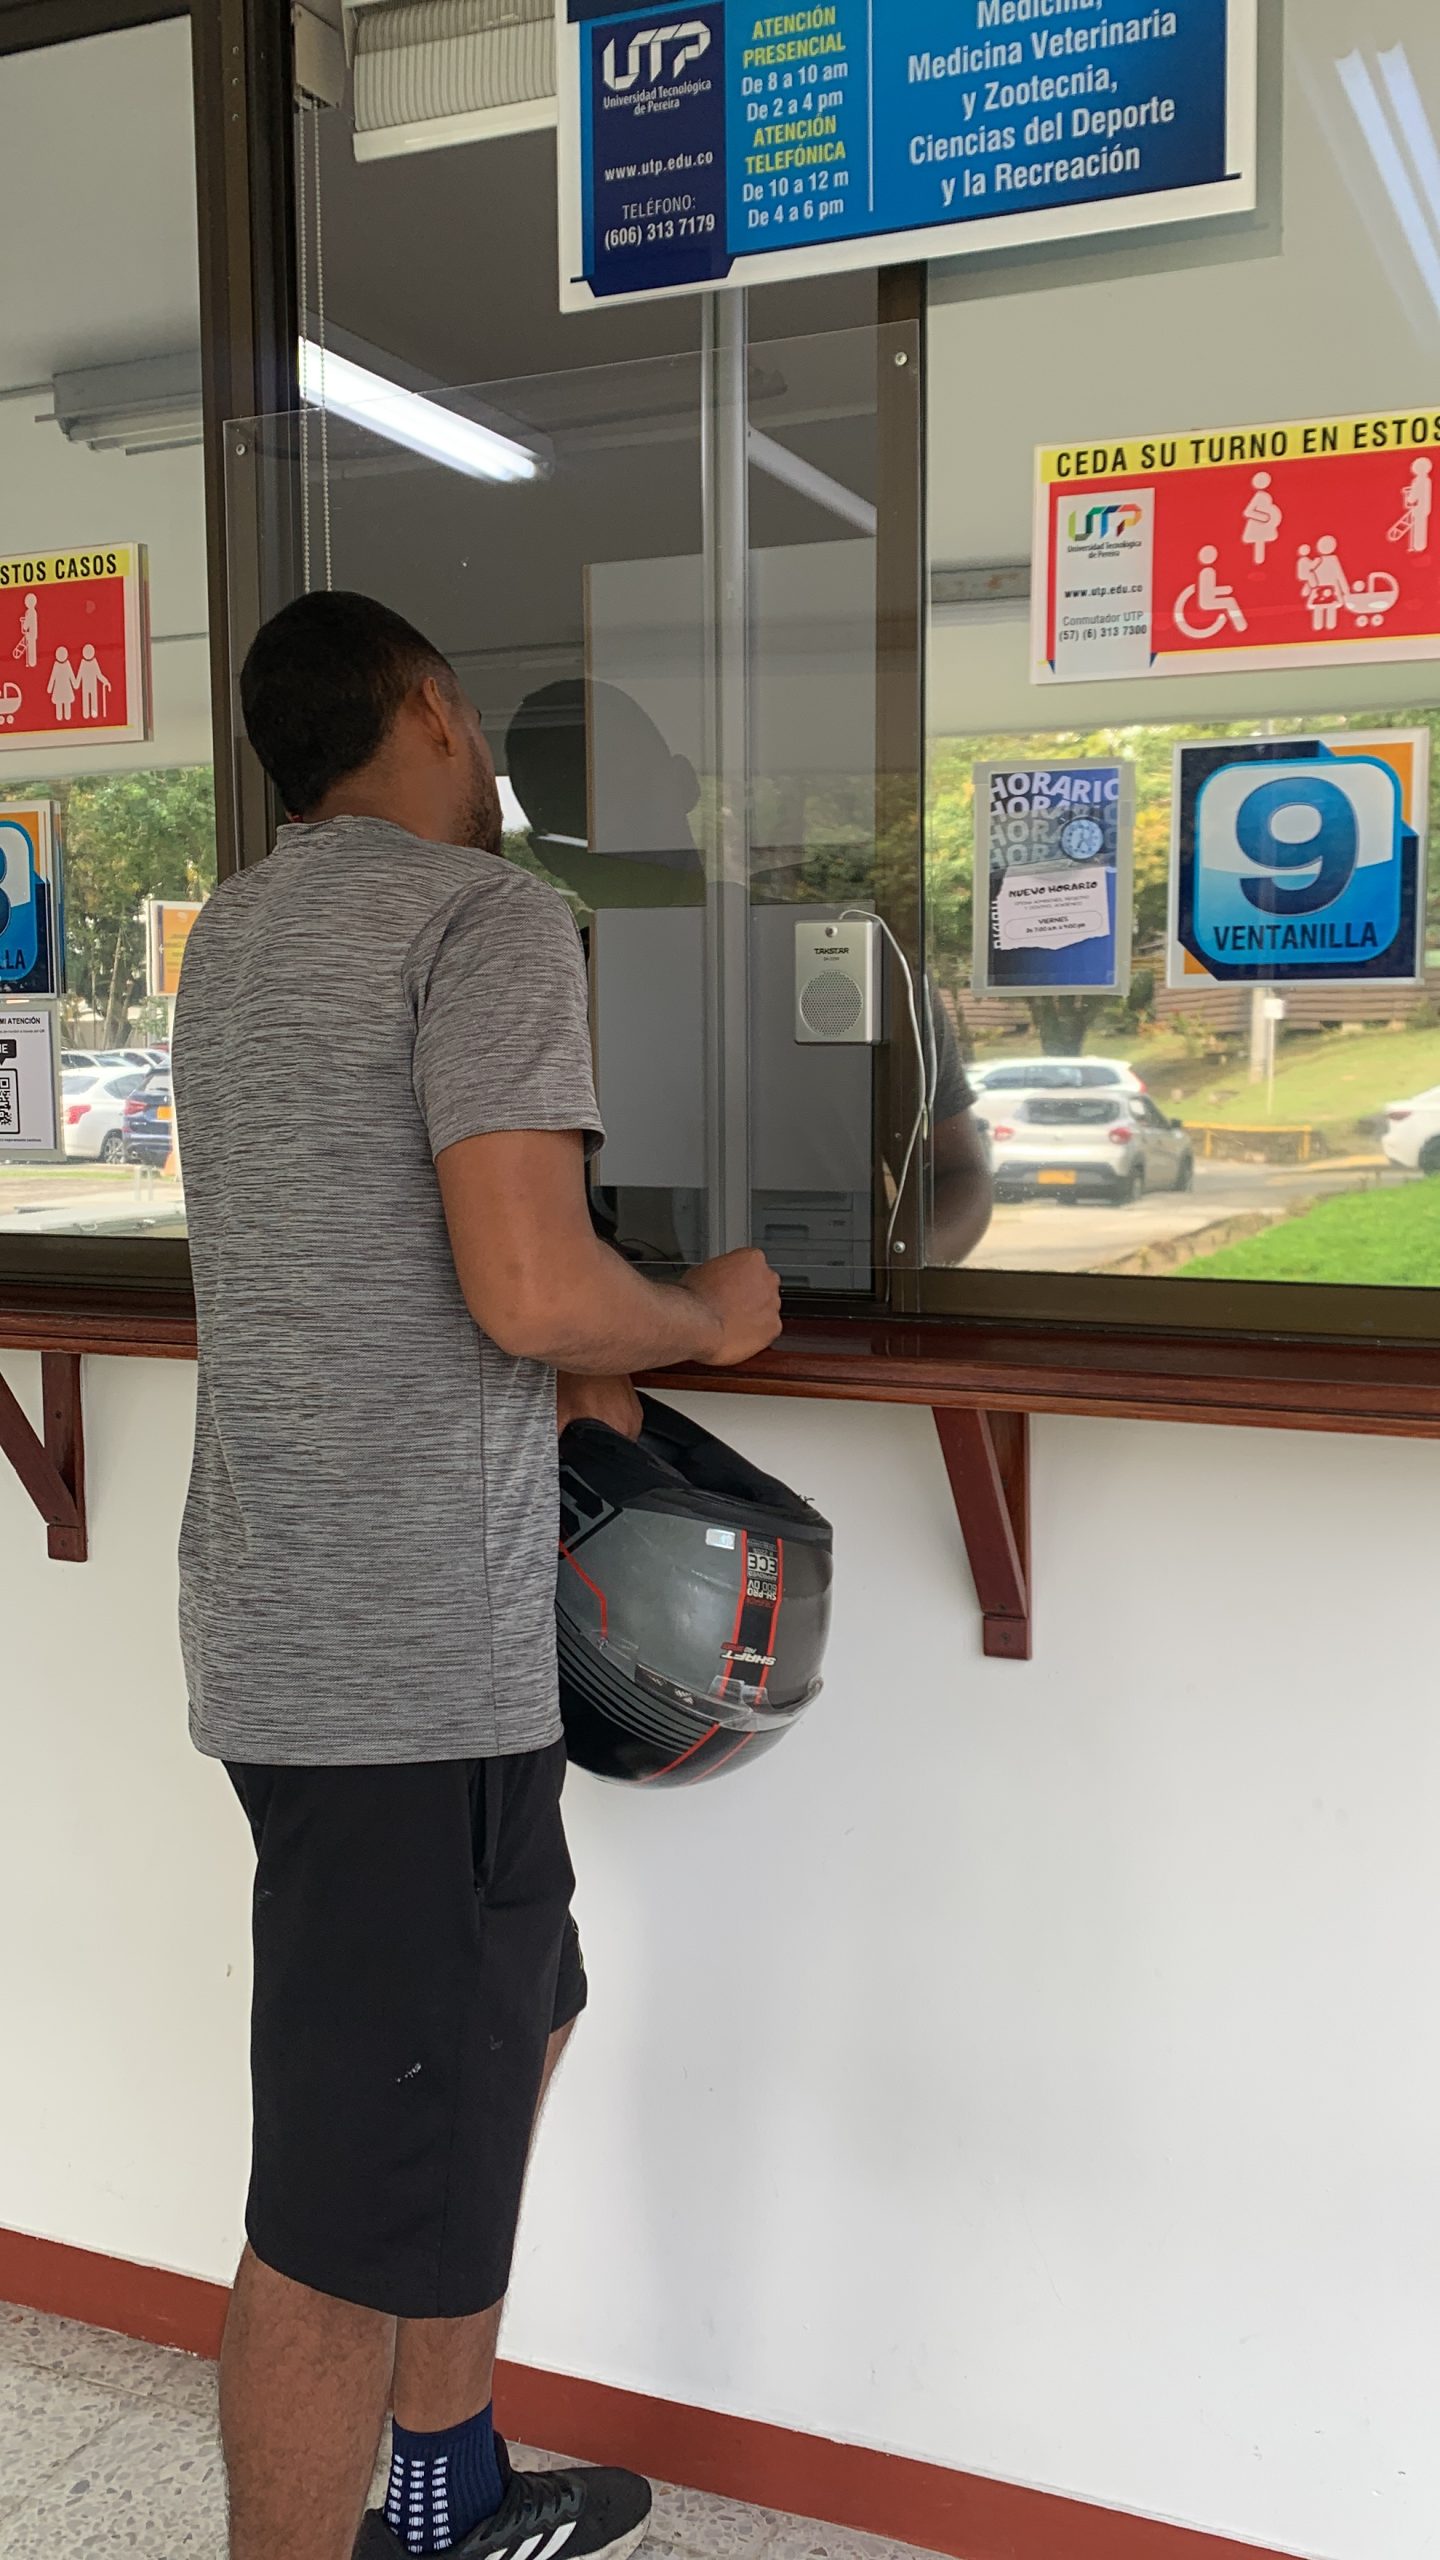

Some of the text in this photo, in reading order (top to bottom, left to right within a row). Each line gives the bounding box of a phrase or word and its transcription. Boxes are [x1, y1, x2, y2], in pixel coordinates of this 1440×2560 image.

[752, 4, 836, 40] ATENCIÓN
[603, 20, 711, 90] UTP
[743, 32, 846, 69] PRESENCIAL
[908, 11, 1177, 83] Medicina Veterinaria
[603, 78, 712, 109] Universidad Tecnológica
[742, 62, 848, 96] De 8 a 10 am
[962, 64, 1119, 121] y Zootecnia,
[634, 98, 680, 116] de Pereira
[747, 90, 843, 122] De 2 a 4 pm
[753, 113, 836, 148] ATENCIÓN
[909, 97, 1175, 165] Ciencias del Deporte
[604, 151, 714, 181] www.utp.edu.co
[745, 141, 846, 175] TELEFÓNICA
[743, 170, 849, 202] De 10 a 12 m
[941, 144, 1140, 207] y la Recreación
[622, 194, 696, 220] TELÉFONO:
[748, 198, 844, 229] De 4 a 6 pm
[604, 213, 715, 250] (606) 313 7179
[1057, 447, 1128, 478] CEDA
[1141, 442, 1176, 469] SU
[1190, 431, 1288, 464] TURNO
[1303, 425, 1338, 454] EN
[1068, 504, 1142, 541] UTP
[0, 553, 116, 585] STOS CASOS
[1064, 584, 1143, 598] www.utp.edu.co
[1059, 629, 1079, 642] (57)
[1083, 628, 1097, 641] (6)
[1100, 626, 1119, 638] 313
[1063, 610, 1144, 627] Conmutador UTP
[1236, 776, 1359, 915] 9
[1009, 881, 1098, 898] NUEVO HORARIO
[1214, 922, 1378, 951] VENTANILLA
[8, 1016, 41, 1025] ATENCIÓN
[748, 1554, 777, 1574] ECE
[721, 1650, 776, 1665] SHAFT
